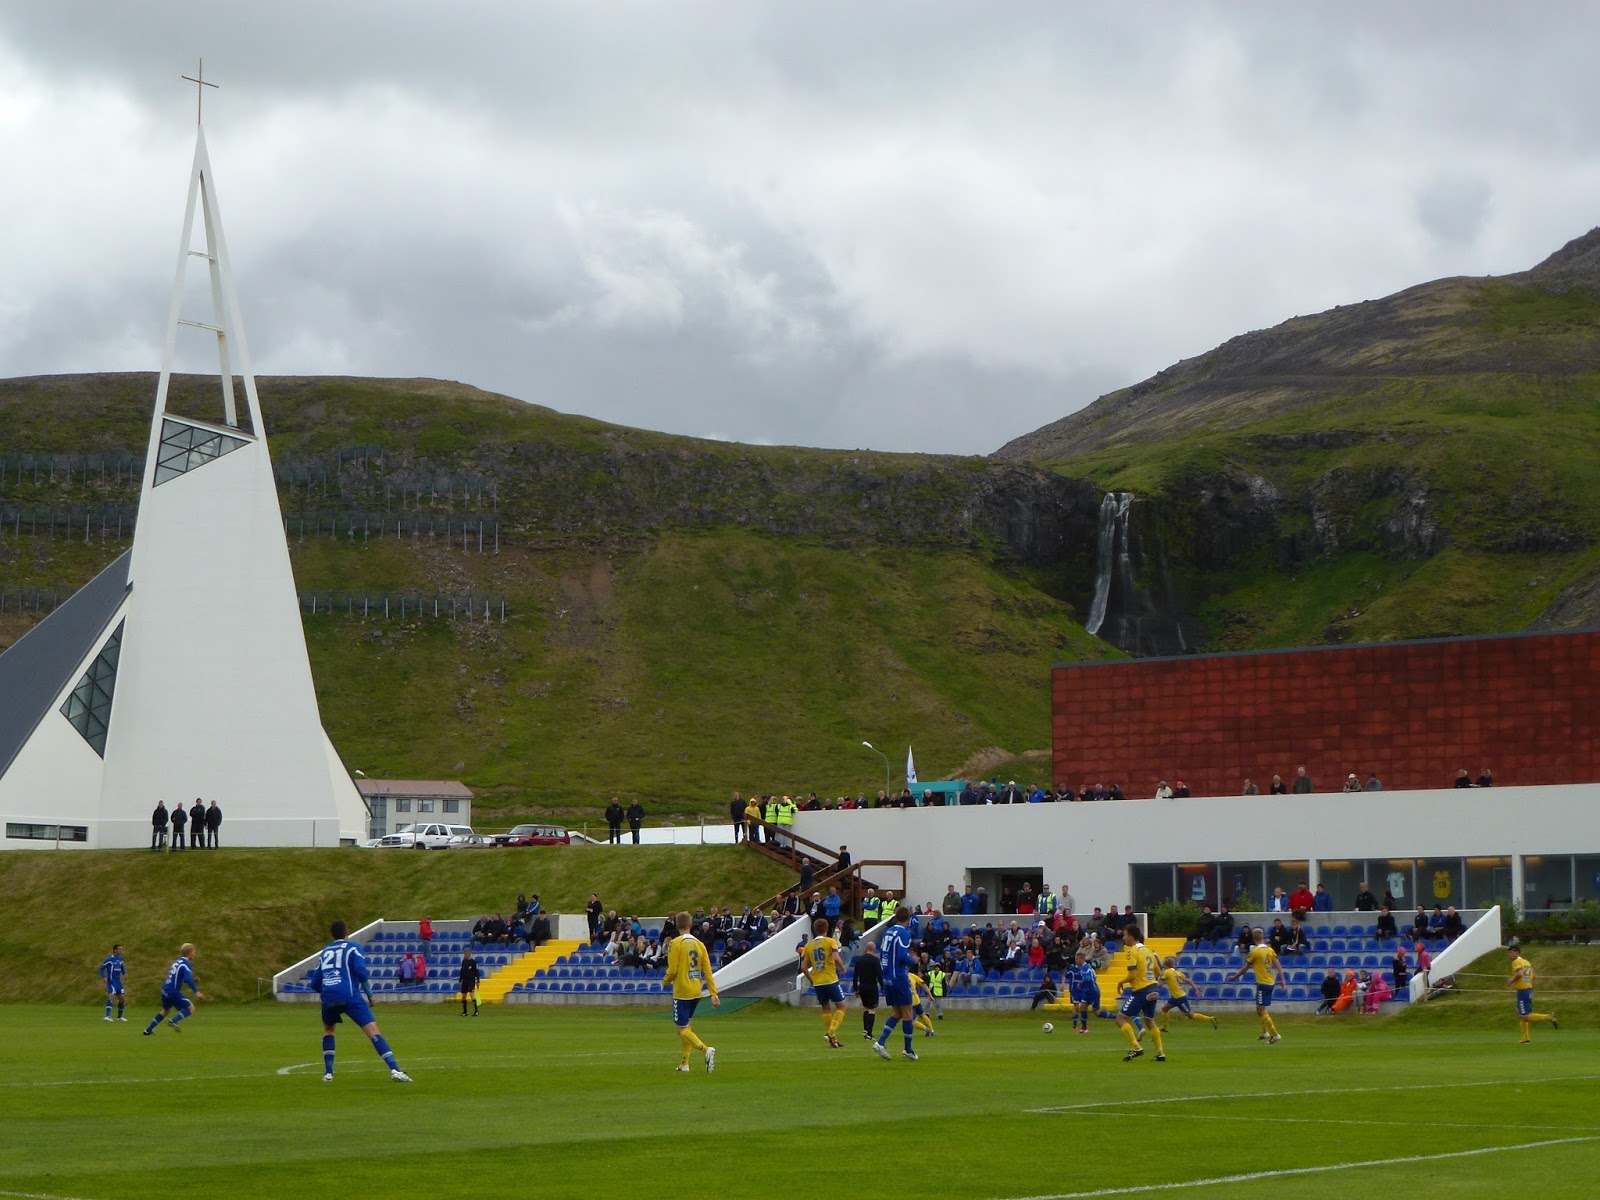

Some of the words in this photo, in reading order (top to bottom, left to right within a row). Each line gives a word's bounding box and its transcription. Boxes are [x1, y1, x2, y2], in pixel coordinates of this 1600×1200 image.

[321, 948, 344, 970] 21
[688, 950, 699, 968] 3
[813, 947, 826, 962] 16
[1145, 955, 1153, 971] 2
